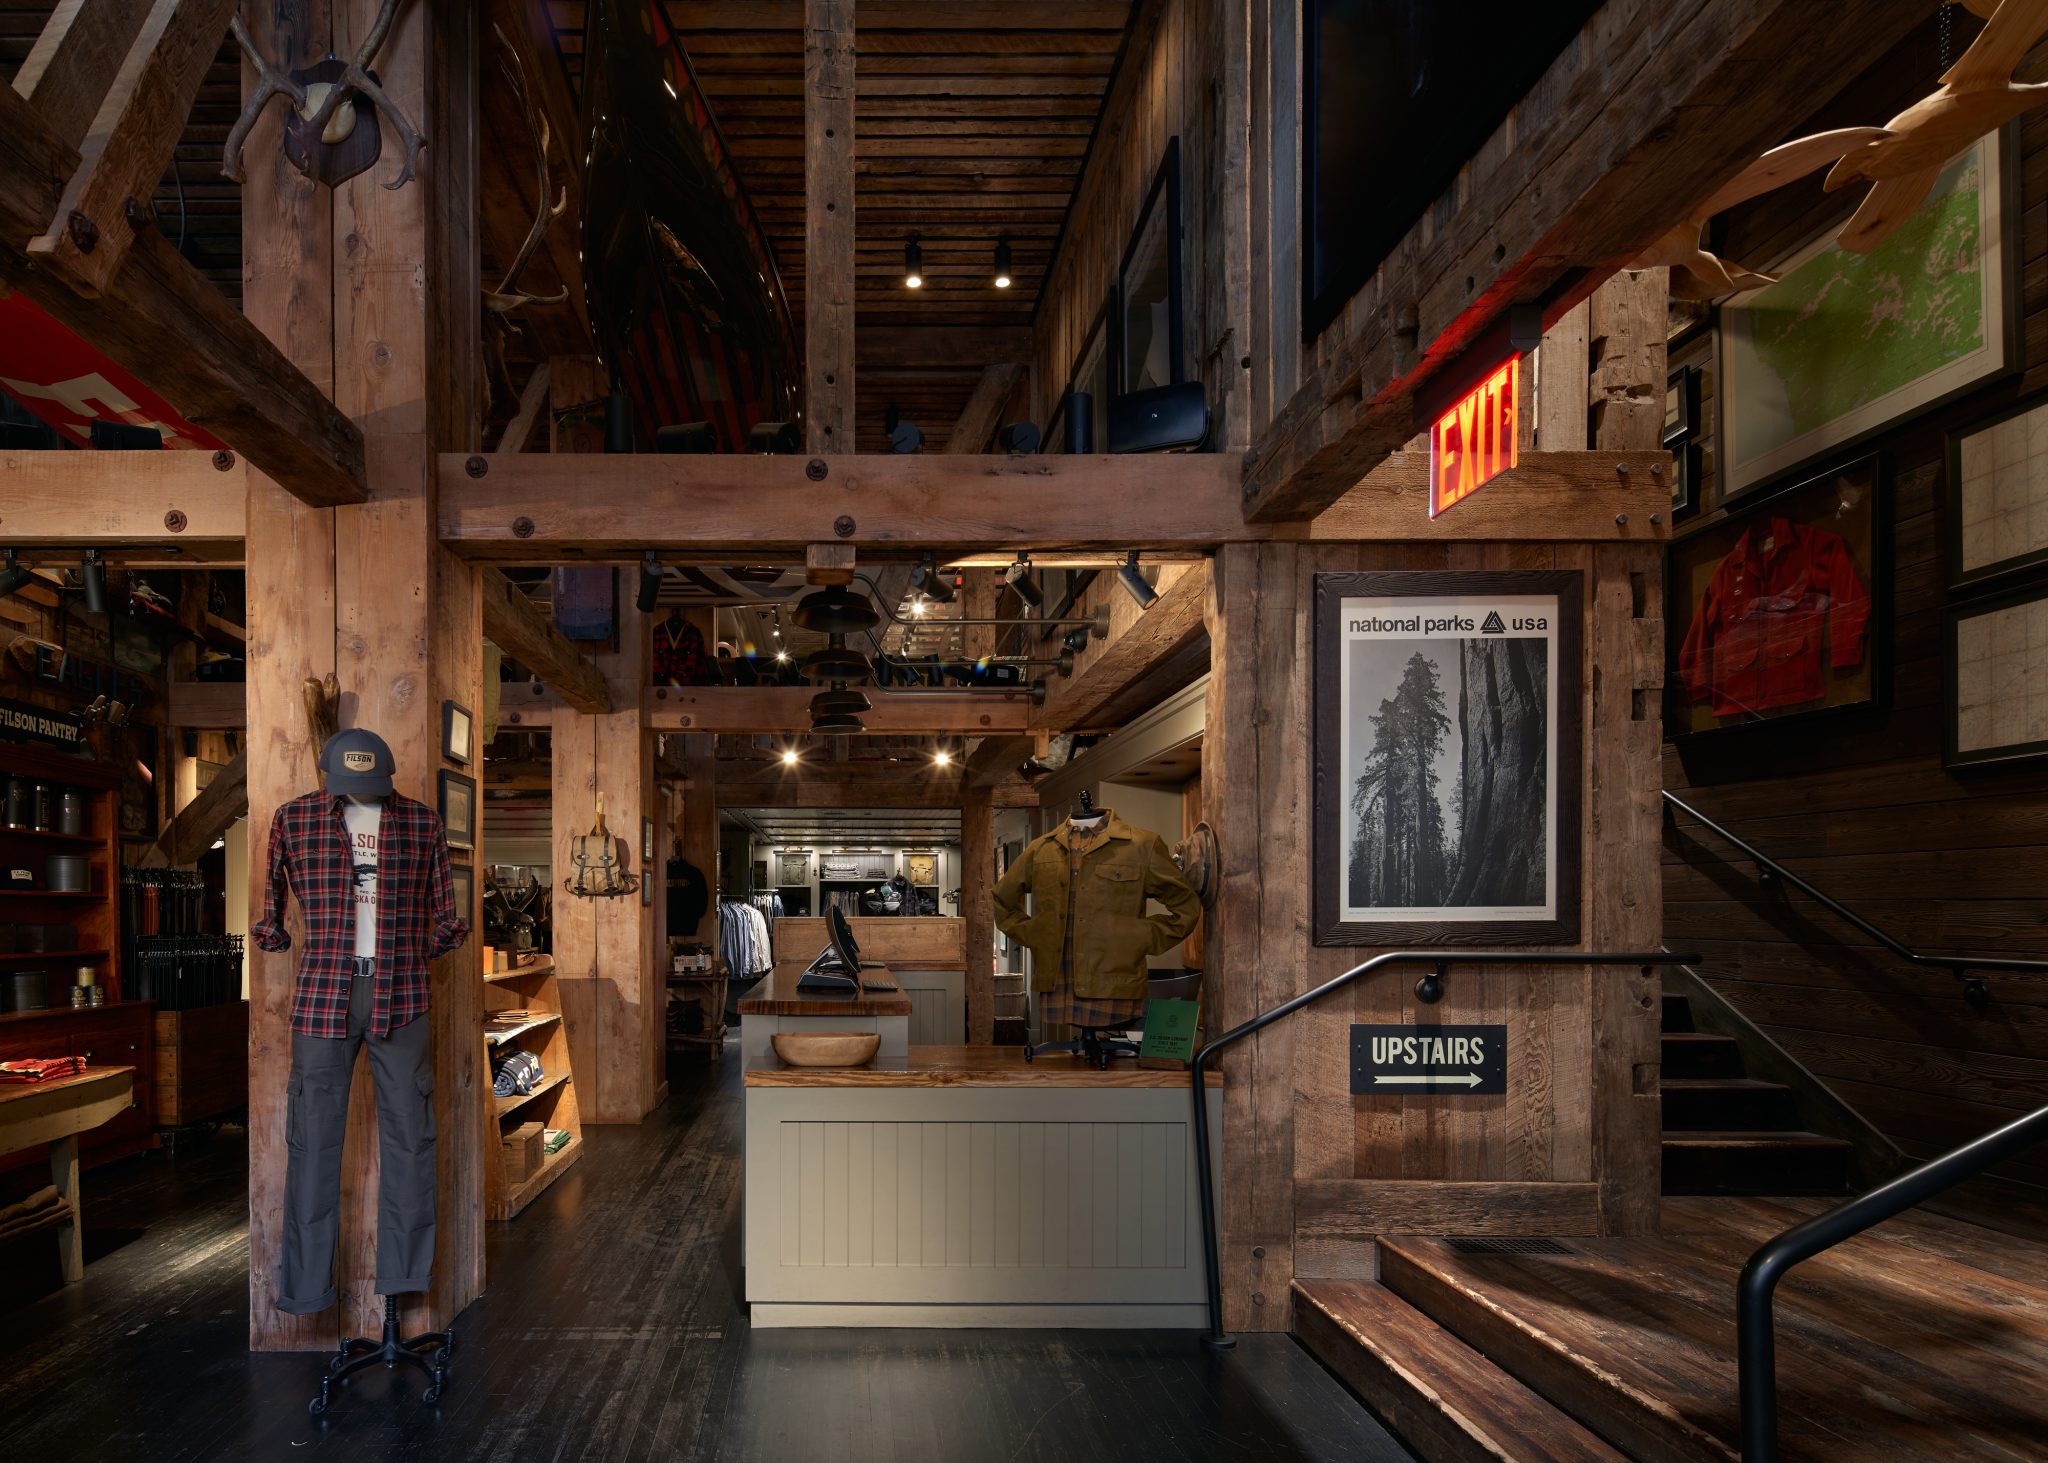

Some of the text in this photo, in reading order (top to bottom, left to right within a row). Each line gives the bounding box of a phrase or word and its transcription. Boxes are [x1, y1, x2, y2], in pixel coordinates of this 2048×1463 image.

[1439, 368, 1508, 511] EXIT
[1349, 615, 1548, 635] national parks usa
[38, 718, 79, 742] PANTRY
[346, 753, 372, 763] FILSON
[1372, 1036, 1485, 1065] UPSTAIRS
